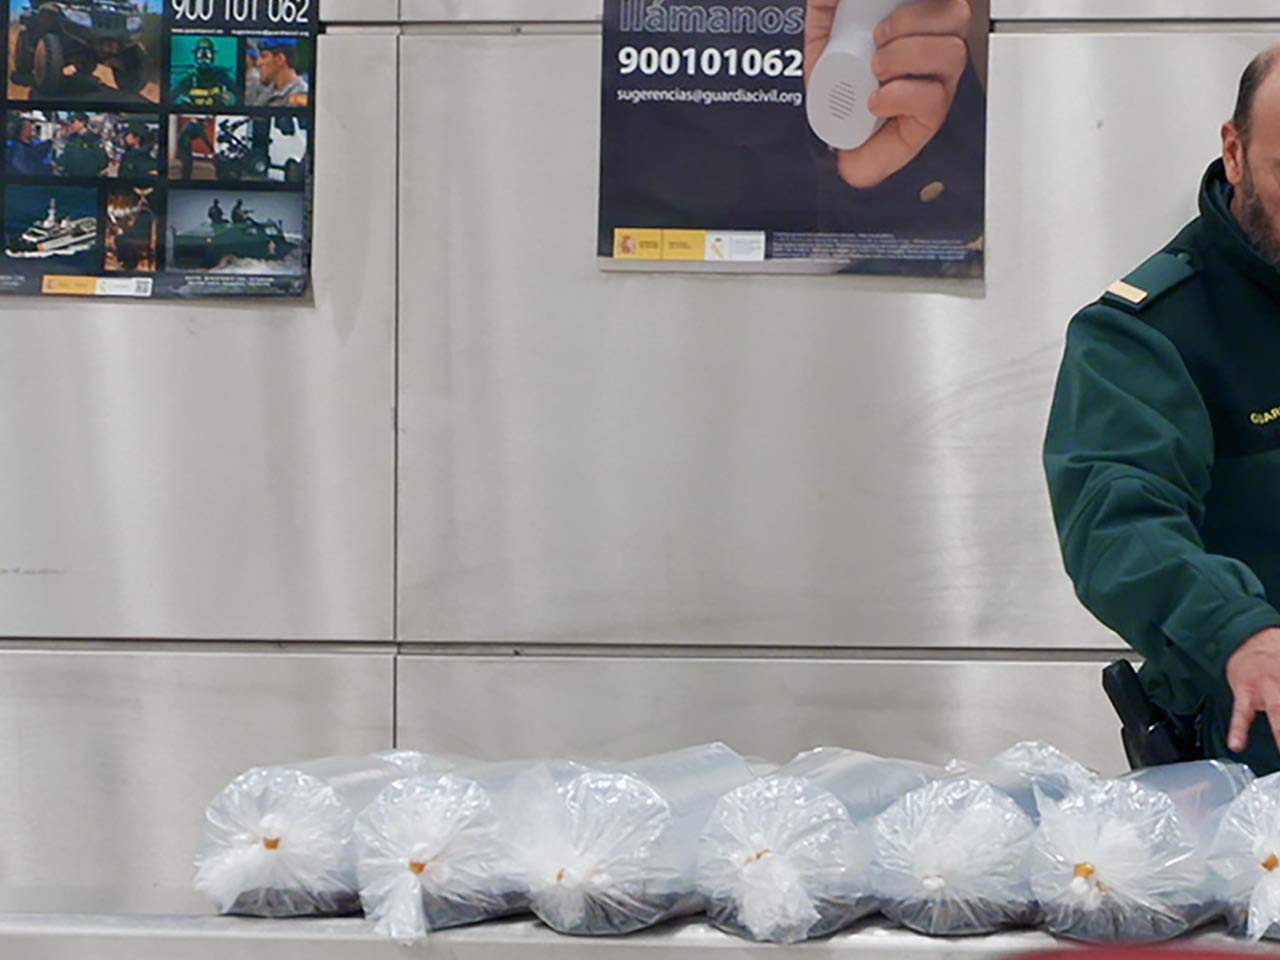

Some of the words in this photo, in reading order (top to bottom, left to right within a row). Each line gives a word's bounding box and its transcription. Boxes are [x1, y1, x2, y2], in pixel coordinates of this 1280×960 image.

[171, 0, 213, 20] 900
[268, 0, 309, 22] 062
[620, 0, 804, 34] llámanos
[618, 46, 803, 76] 900101062
[617, 89, 802, 105] sugerencias@guardiacivil.org
